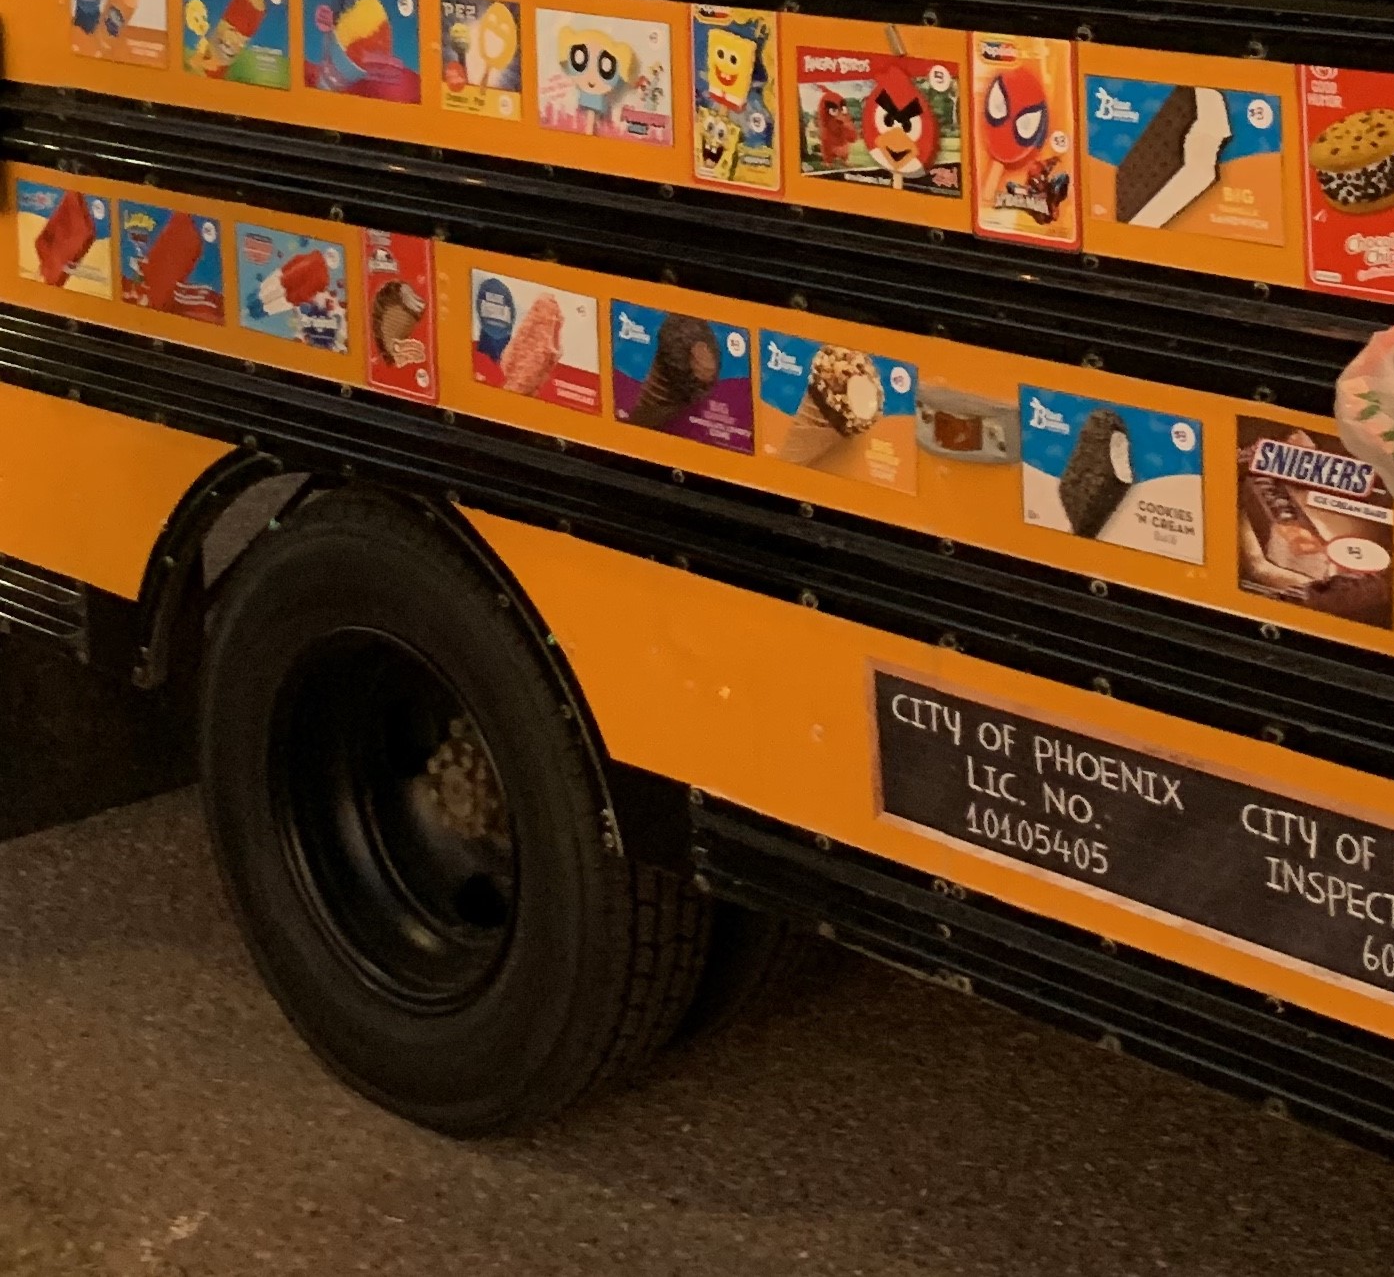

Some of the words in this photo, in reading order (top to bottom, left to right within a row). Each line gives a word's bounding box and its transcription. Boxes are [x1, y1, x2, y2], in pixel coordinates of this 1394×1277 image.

[442, 2, 476, 21] PEZ
[1256, 442, 1373, 494] SNICKERS
[1137, 500, 1194, 523] COOKIES
[1152, 517, 1196, 536] CREAM
[1329, 498, 1361, 513] CREAM
[892, 693, 961, 745] CITY
[978, 721, 1017, 756] OF
[1034, 735, 1185, 811] PHOENIX
[967, 755, 1027, 806] LIC.
[1042, 781, 1102, 829] NO.
[966, 801, 1109, 874] 10105405
[1242, 804, 1317, 859] CITY
[1336, 833, 1376, 871] OF
